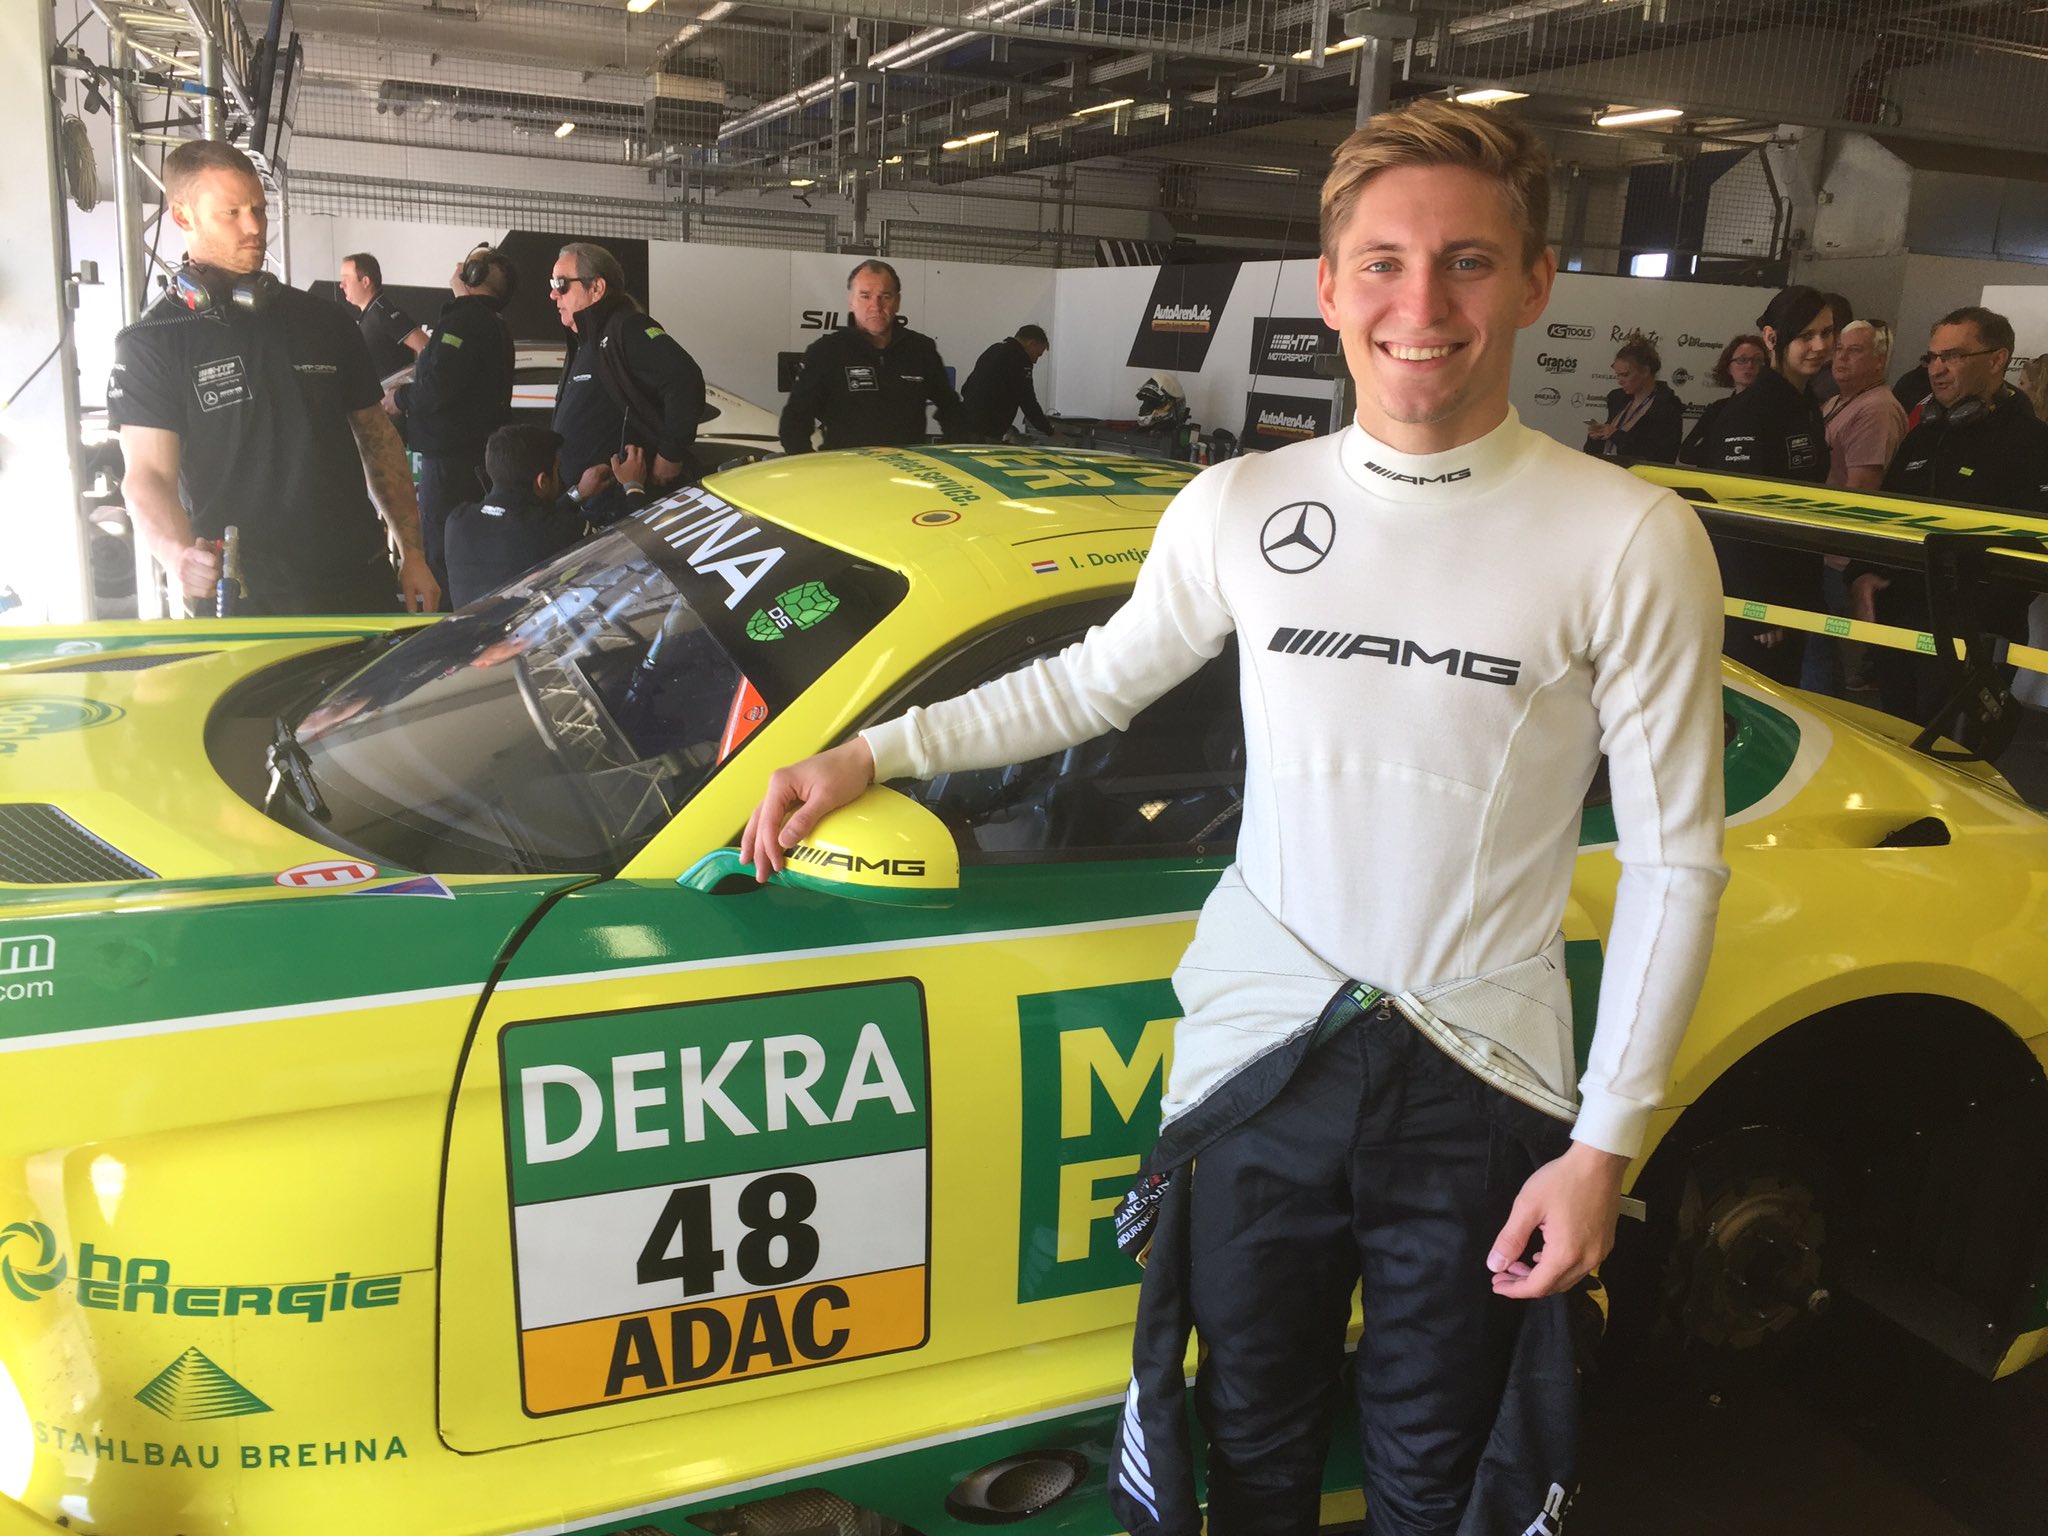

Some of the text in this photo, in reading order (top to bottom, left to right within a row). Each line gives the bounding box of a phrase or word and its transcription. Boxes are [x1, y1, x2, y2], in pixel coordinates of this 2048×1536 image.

[1567, 328, 1592, 337] TOOLS
[1267, 352, 1313, 362] MOTORSPORT
[1385, 465, 1472, 486] AMG
[914, 471, 981, 507] service.
[1069, 555, 1085, 569] I.
[768, 606, 793, 630] DS
[1826, 626, 1849, 635] FILTER
[1828, 618, 1850, 628] MANN
[1330, 634, 1521, 686] AMG
[815, 851, 926, 877] AMG
[520, 1022, 917, 1165] DEKRA
[636, 1171, 821, 1299] 48
[603, 1284, 851, 1398] ADAC
[35, 1420, 408, 1469] STAHLBAU BREHNA
